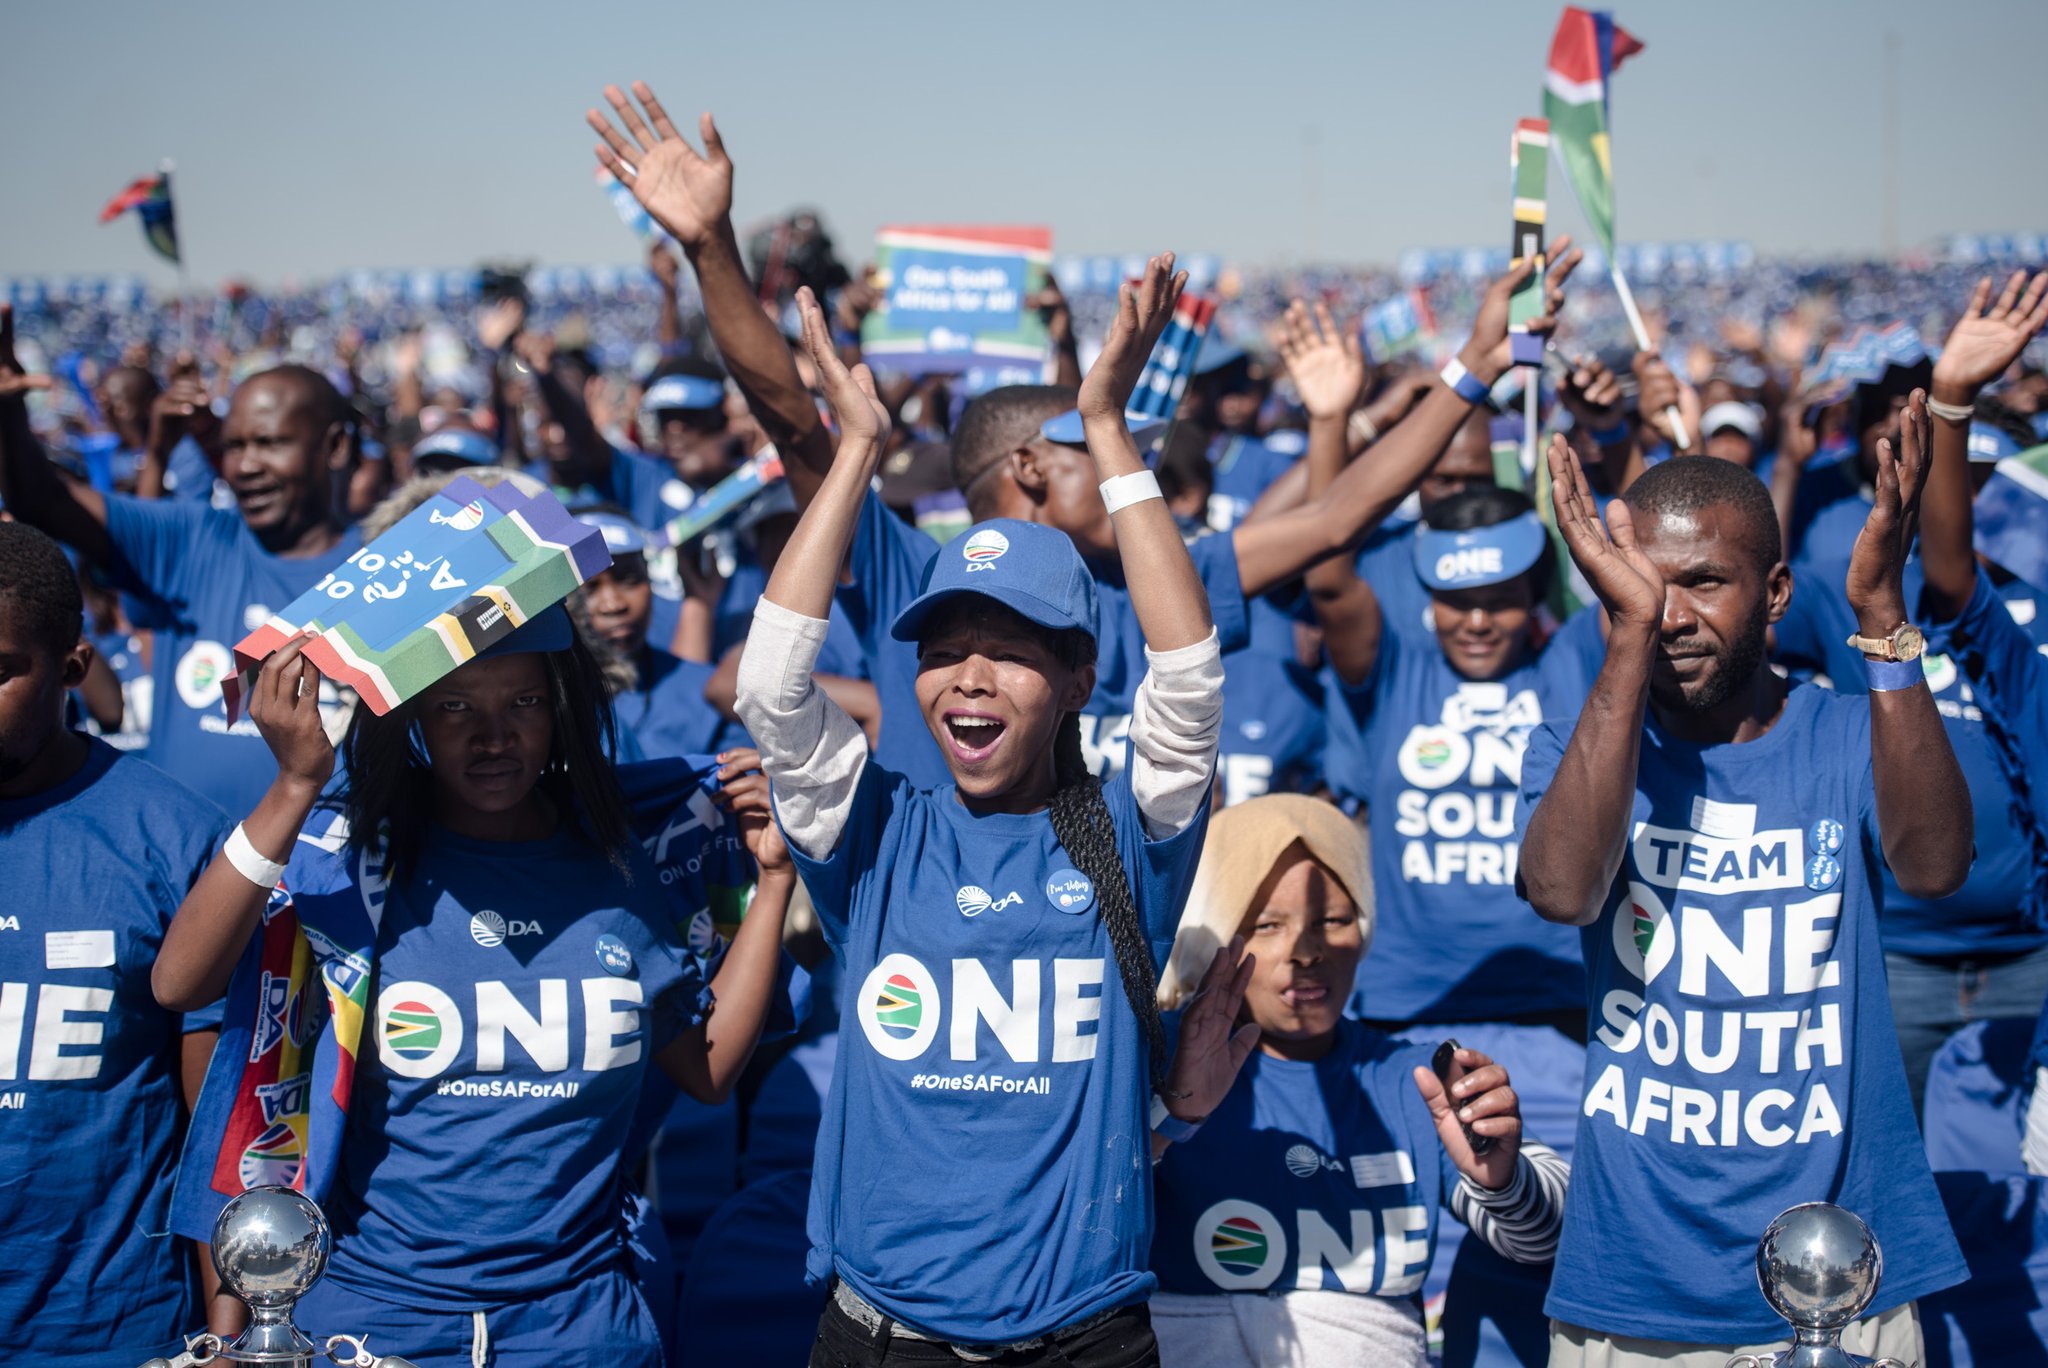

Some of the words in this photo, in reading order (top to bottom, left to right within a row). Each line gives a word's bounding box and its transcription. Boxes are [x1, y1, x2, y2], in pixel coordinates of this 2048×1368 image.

[966, 561, 996, 572] DA
[1436, 547, 1502, 580] ONE
[1397, 724, 1524, 788] ON
[1395, 790, 1516, 838] SOU
[1402, 840, 1518, 884] AFRI
[1649, 837, 1787, 884] TEAM
[991, 891, 1024, 912] DA
[1050, 884, 1063, 895] I'm
[1063, 879, 1089, 893] Voting
[1073, 894, 1087, 902] DA
[0, 915, 20, 930] A
[508, 920, 543, 936] DA
[1611, 881, 1842, 997] ONE
[263, 979, 290, 1051] DA
[373, 977, 644, 1079] ONE
[857, 953, 1105, 1063] ONE
[1595, 988, 1843, 1074] SOUTH
[263, 1085, 304, 1123] DA
[437, 1079, 579, 1099] #OneSAForAll
[911, 1073, 1050, 1095] #OneSAForAll
[1583, 1063, 1844, 1147] AFRICA
[1193, 1199, 1429, 1296] ONE
